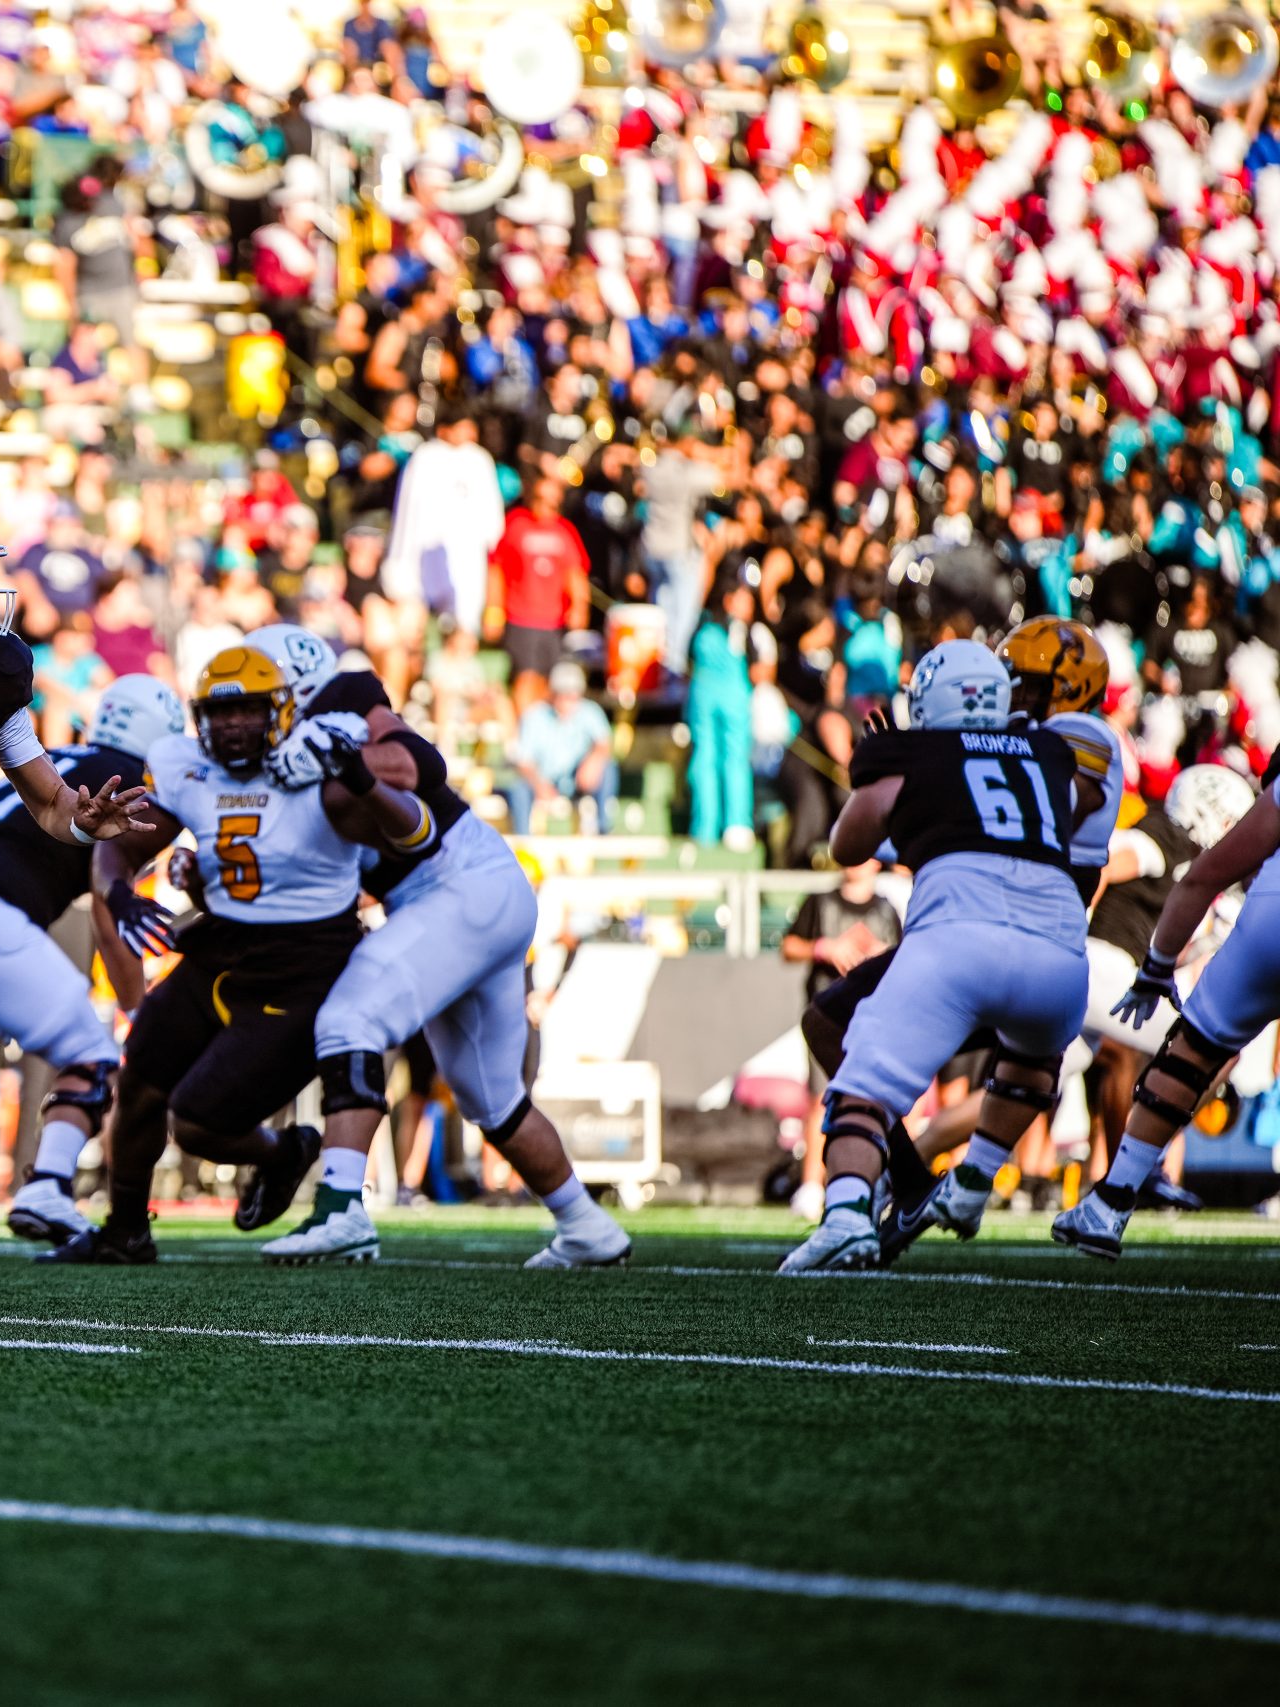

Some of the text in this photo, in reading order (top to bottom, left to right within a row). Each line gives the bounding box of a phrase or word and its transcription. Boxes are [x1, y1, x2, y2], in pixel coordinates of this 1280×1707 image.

[960, 732, 1034, 757] BRONSON
[216, 793, 269, 809] IDAHO
[963, 757, 1063, 852] 61
[214, 813, 263, 902] 5
